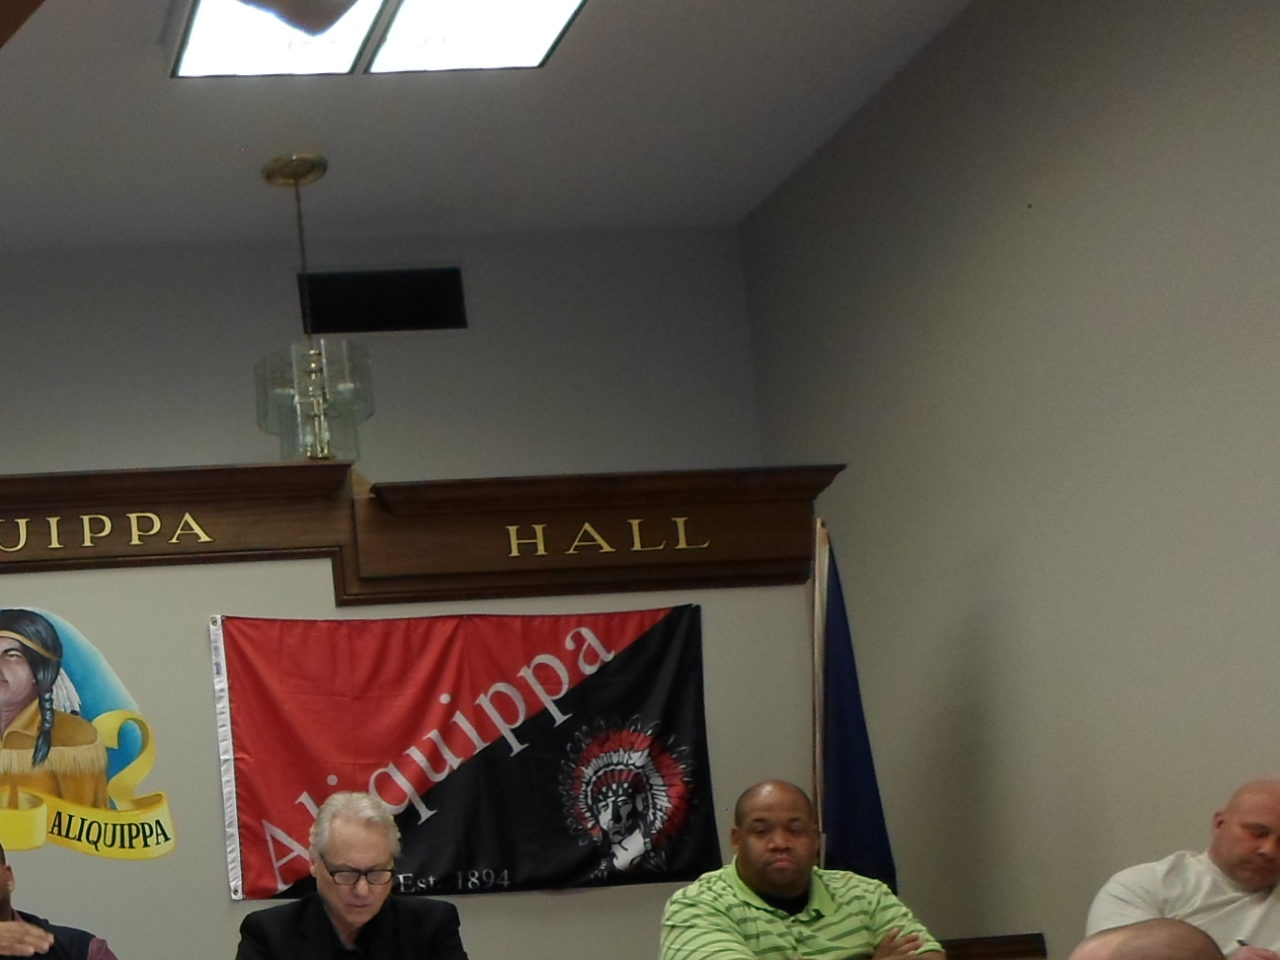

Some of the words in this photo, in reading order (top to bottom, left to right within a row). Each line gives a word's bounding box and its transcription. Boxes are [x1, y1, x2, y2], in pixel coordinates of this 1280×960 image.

[506, 516, 711, 557] HALL
[262, 626, 615, 893] Aquippa
[48, 811, 171, 849] ALIQUIPPA
[456, 869, 510, 890] 1894
